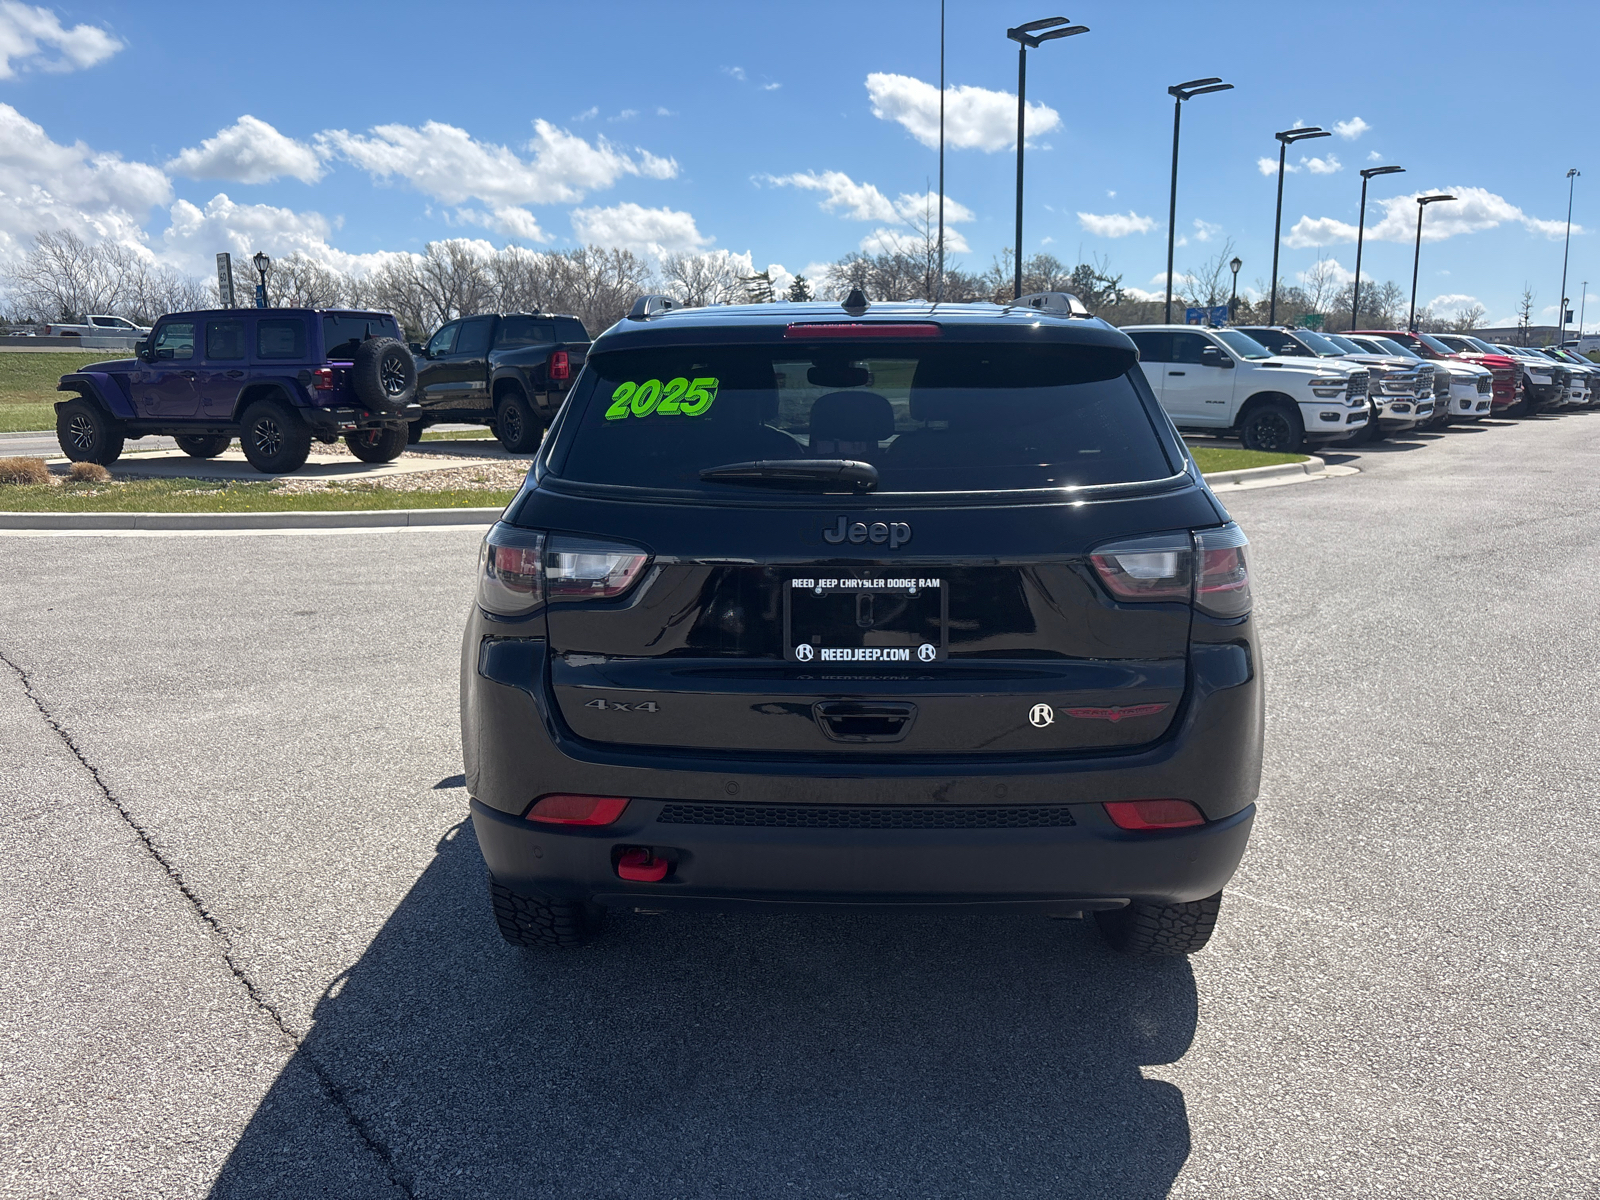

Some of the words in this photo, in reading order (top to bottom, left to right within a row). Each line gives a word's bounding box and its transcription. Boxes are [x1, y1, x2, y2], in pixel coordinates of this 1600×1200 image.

[605, 377, 719, 420] 2025
[823, 516, 911, 549] Jeep
[792, 579, 815, 588] REED
[816, 579, 838, 588] JEEP
[840, 579, 885, 588] CHRYSLER
[887, 579, 917, 588] DODGE
[918, 579, 940, 588] RAM
[821, 649, 909, 661] REEDJEEP.COM
[584, 699, 660, 713] 4x4
[1029, 703, 1055, 728] R
